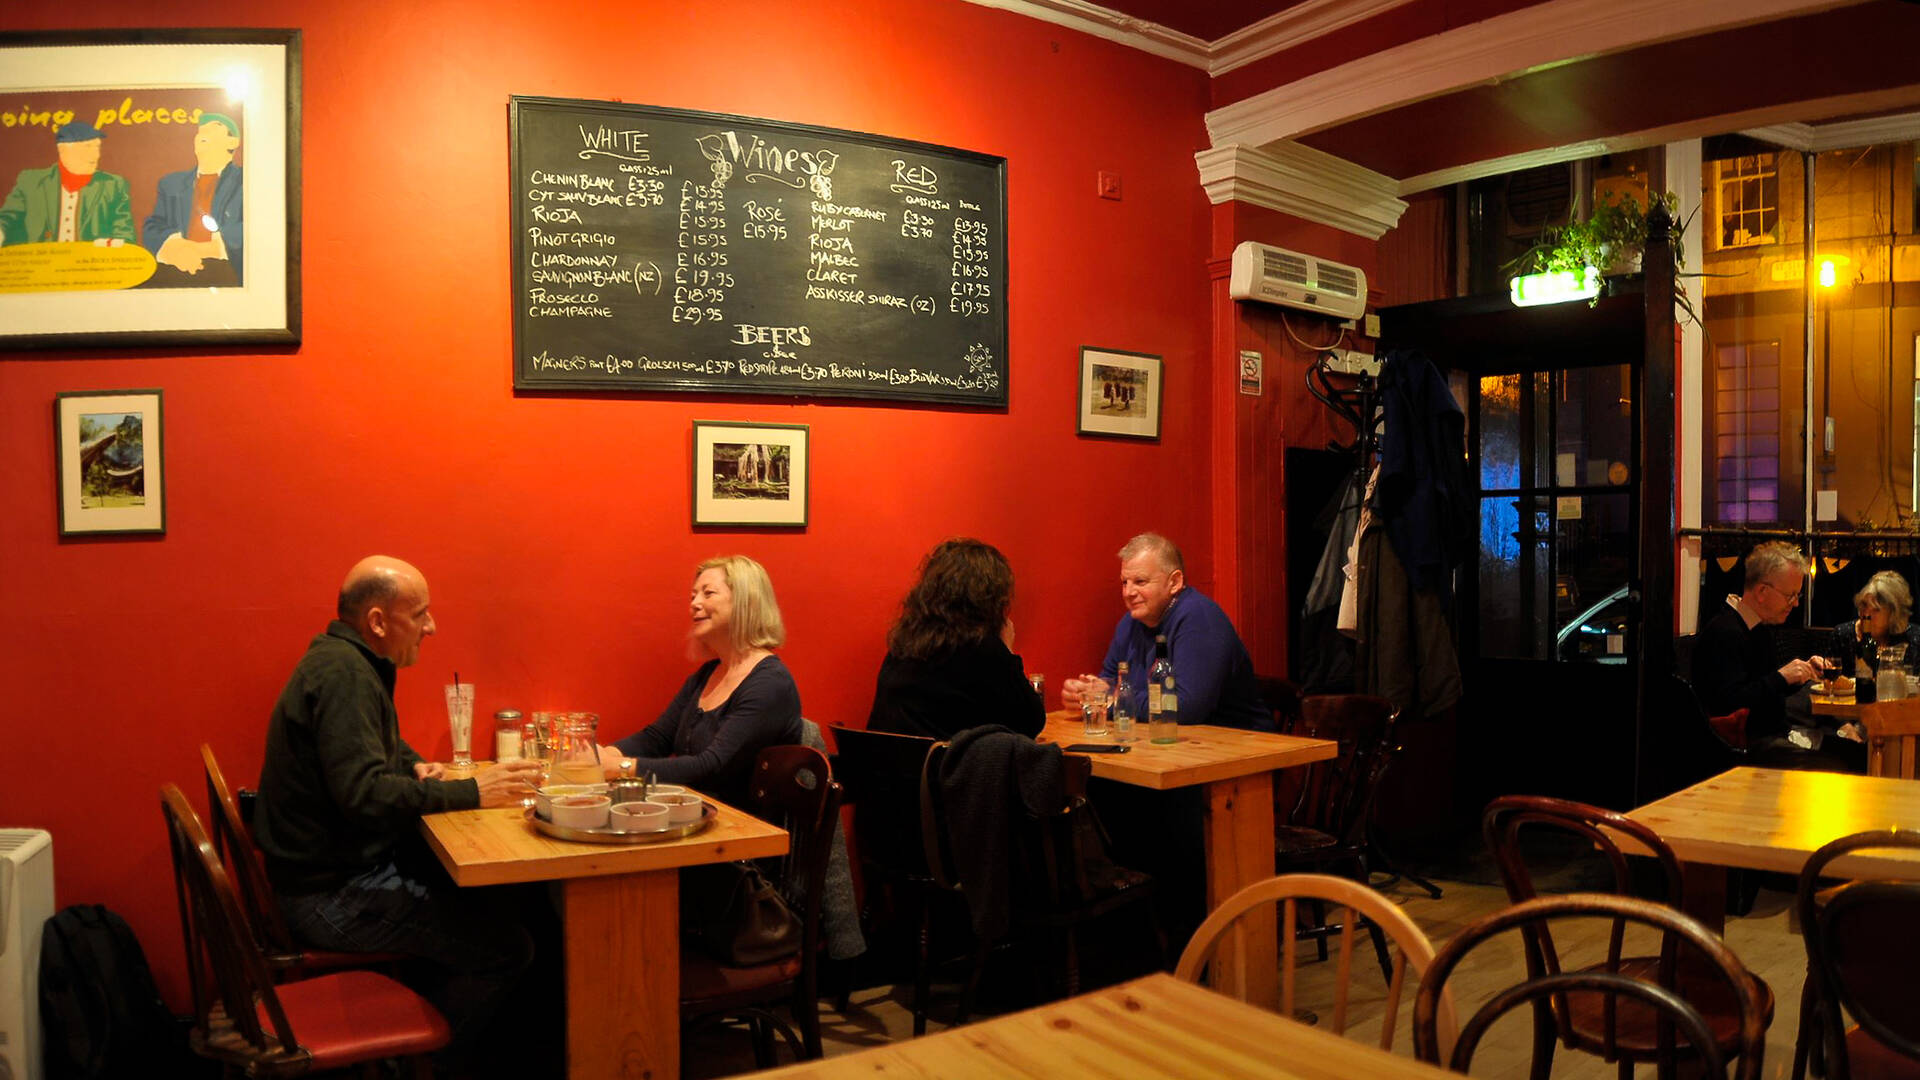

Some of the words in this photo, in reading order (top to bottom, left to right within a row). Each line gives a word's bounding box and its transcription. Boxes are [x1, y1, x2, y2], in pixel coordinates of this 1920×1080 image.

[94, 97, 202, 130] places
[579, 124, 649, 154] WHITE
[720, 131, 818, 175] Wines
[891, 160, 937, 185] RED
[531, 205, 583, 225] RIOJA
[811, 214, 855, 233] MERLOT
[743, 222, 788, 241] £15.95
[808, 233, 854, 254] RIOJA
[531, 251, 618, 268] CHARDONNAY
[810, 251, 859, 268] MALBEC
[806, 268, 858, 284] CLARET
[529, 287, 599, 304] PROSECCO
[529, 306, 614, 318] CHAMPAGNE
[730, 324, 811, 346] BEERS
[532, 350, 587, 371] MAGNERS
[638, 356, 681, 371] GROLSCH
